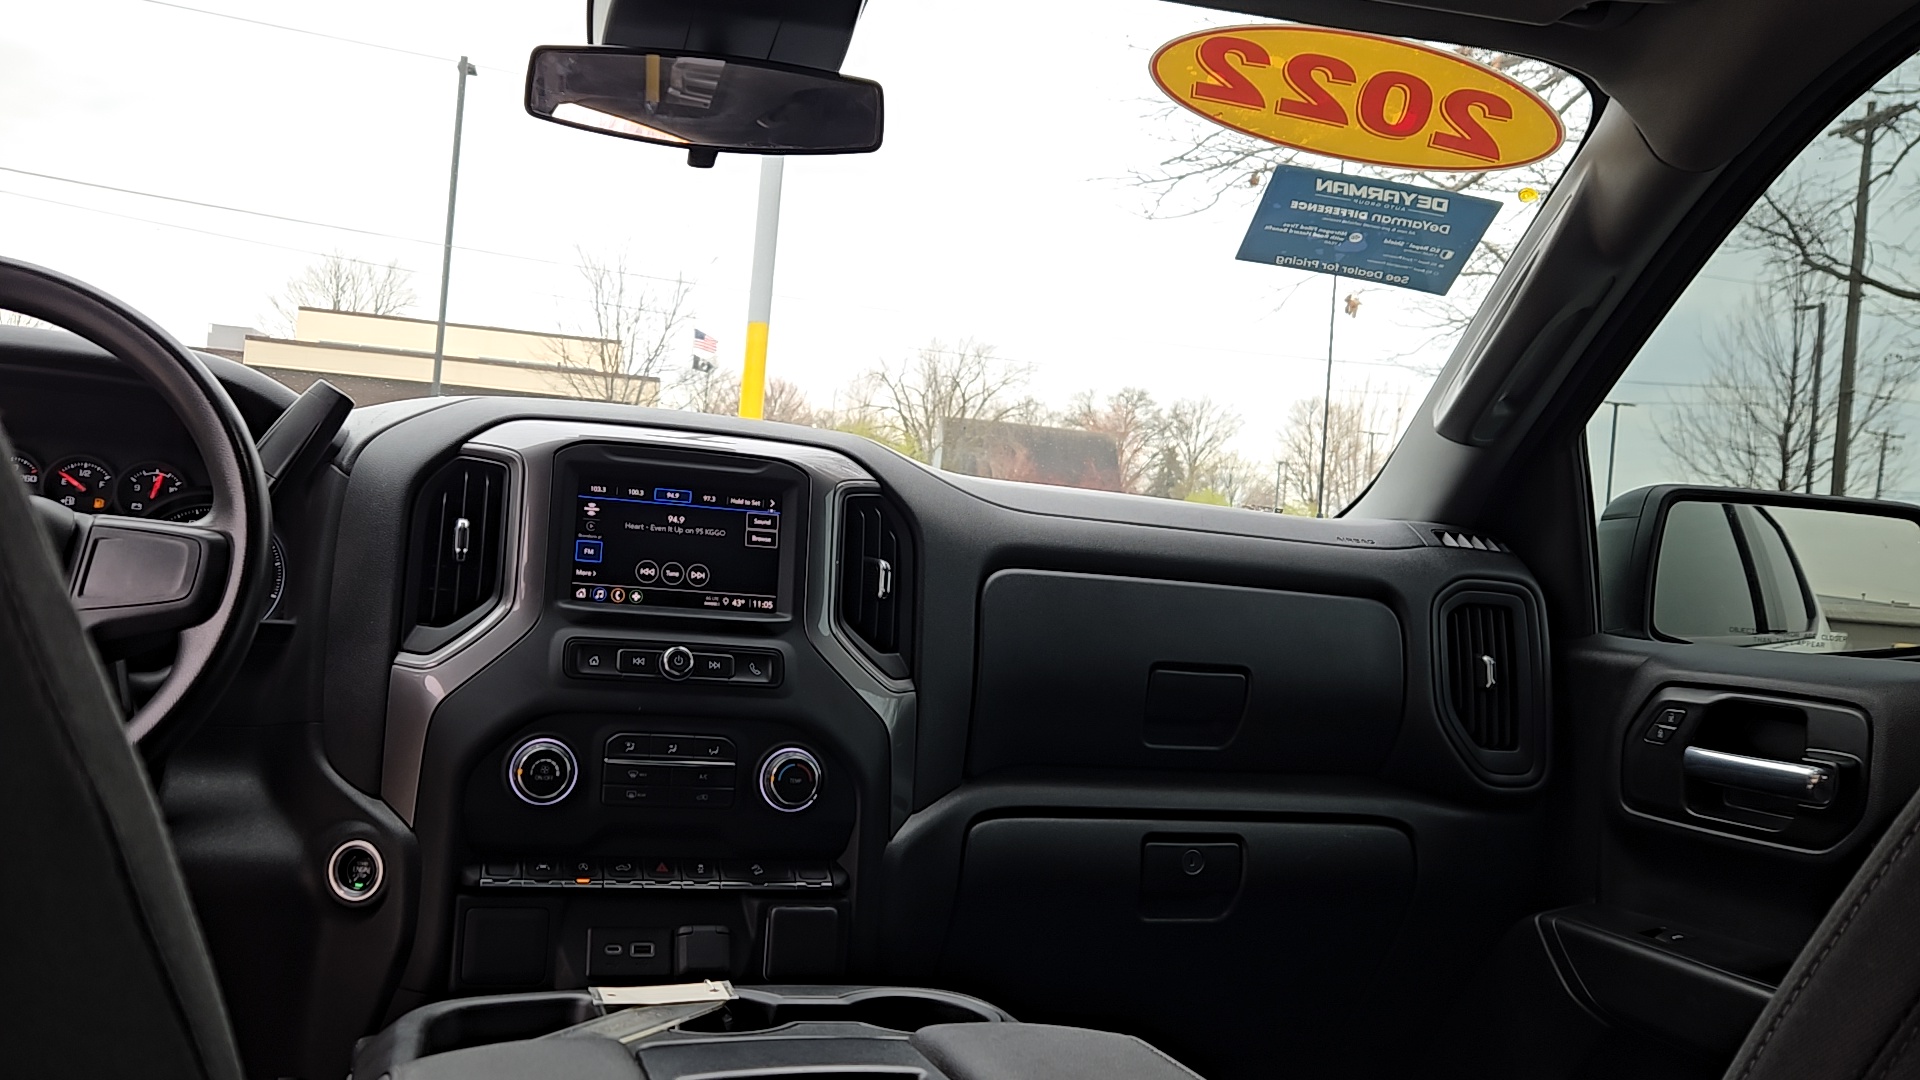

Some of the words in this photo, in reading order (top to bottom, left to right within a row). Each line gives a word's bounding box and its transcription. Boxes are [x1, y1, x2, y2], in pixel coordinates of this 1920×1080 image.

[79, 469, 92, 478] 1/2
[99, 481, 106, 489] F
[133, 484, 141, 492] 9
[590, 485, 607, 493] 103.3
[667, 515, 686, 524] 94.9
[624, 522, 644, 530] Heart
[650, 524, 666, 532] Even
[674, 526, 683, 535] Up
[695, 527, 704, 535] 95
[705, 528, 726, 537] KGGO
[751, 535, 772, 543] Browse
[576, 569, 592, 577] More
[732, 599, 746, 608] 43°
[753, 600, 774, 609] 11:05
